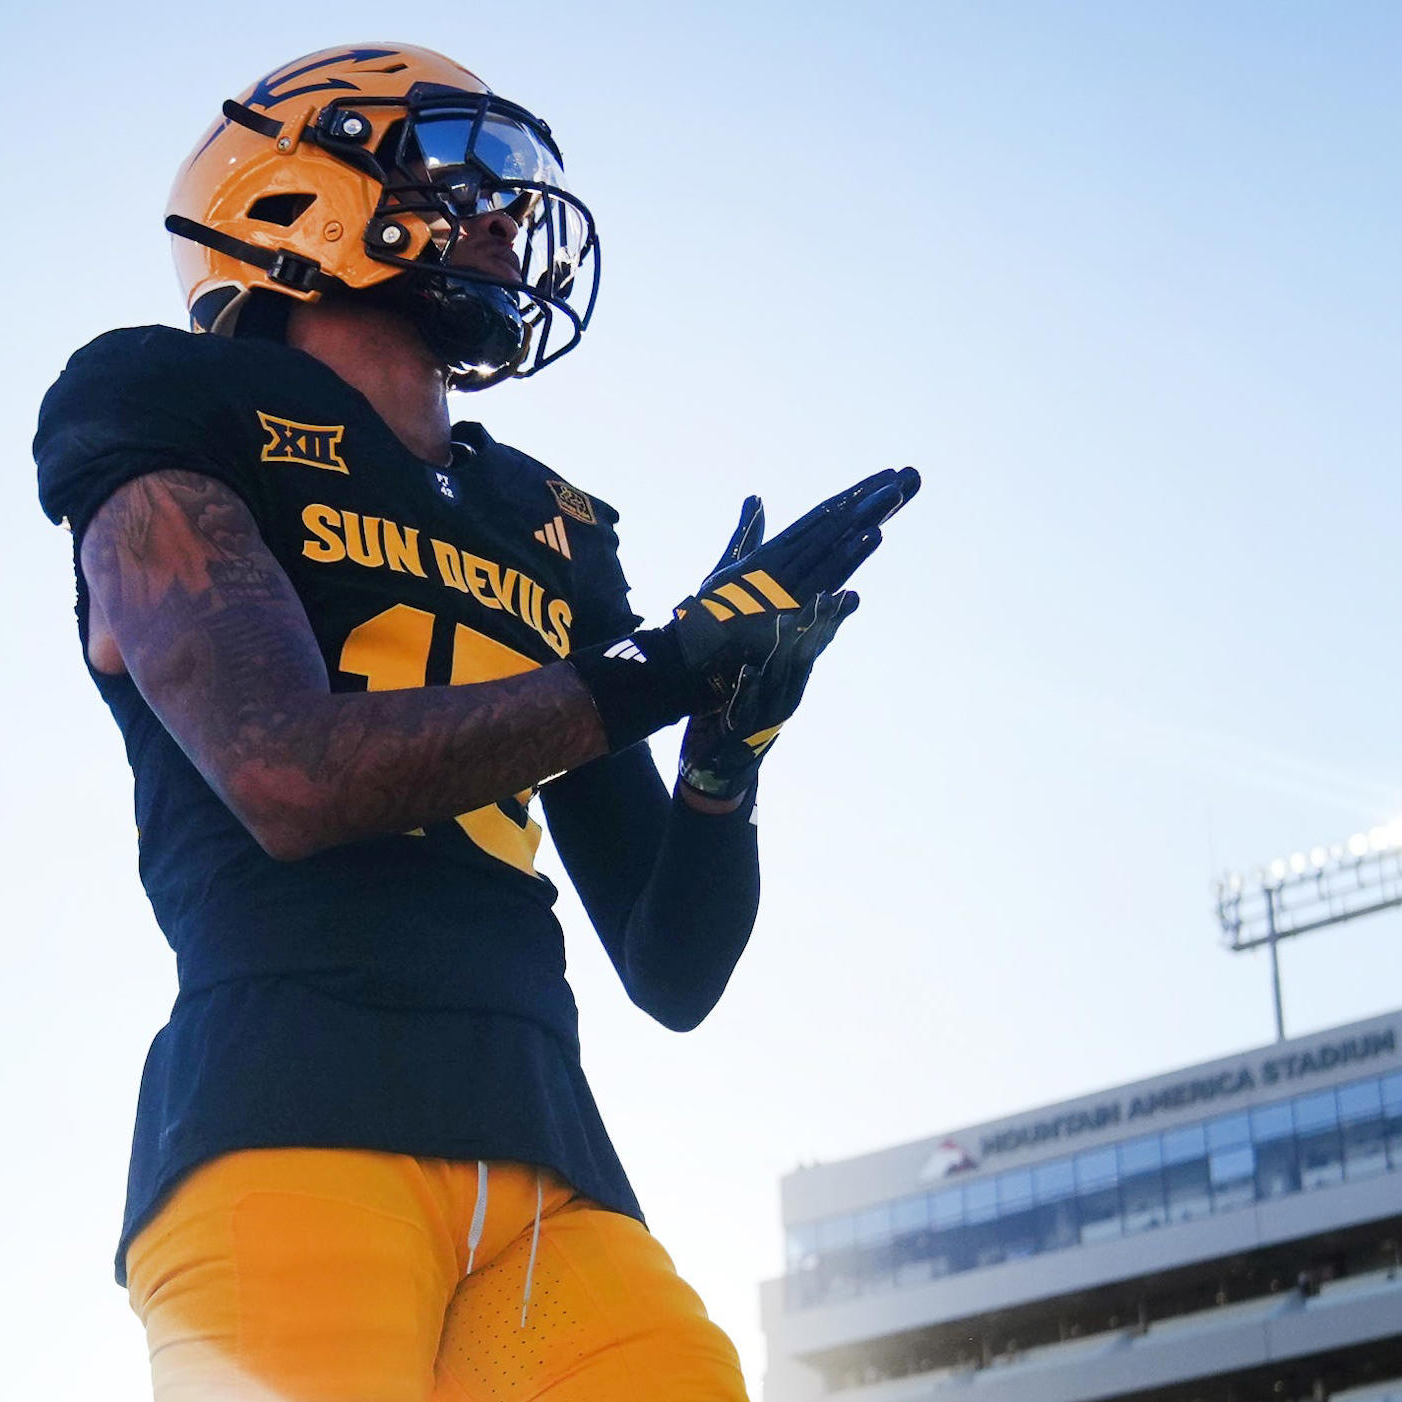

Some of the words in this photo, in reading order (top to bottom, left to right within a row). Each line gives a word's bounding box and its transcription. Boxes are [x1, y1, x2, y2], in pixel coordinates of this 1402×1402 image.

[301, 503, 428, 579] SUN
[430, 538, 573, 660] DEVILS
[1261, 1029, 1396, 1086] STADIUM
